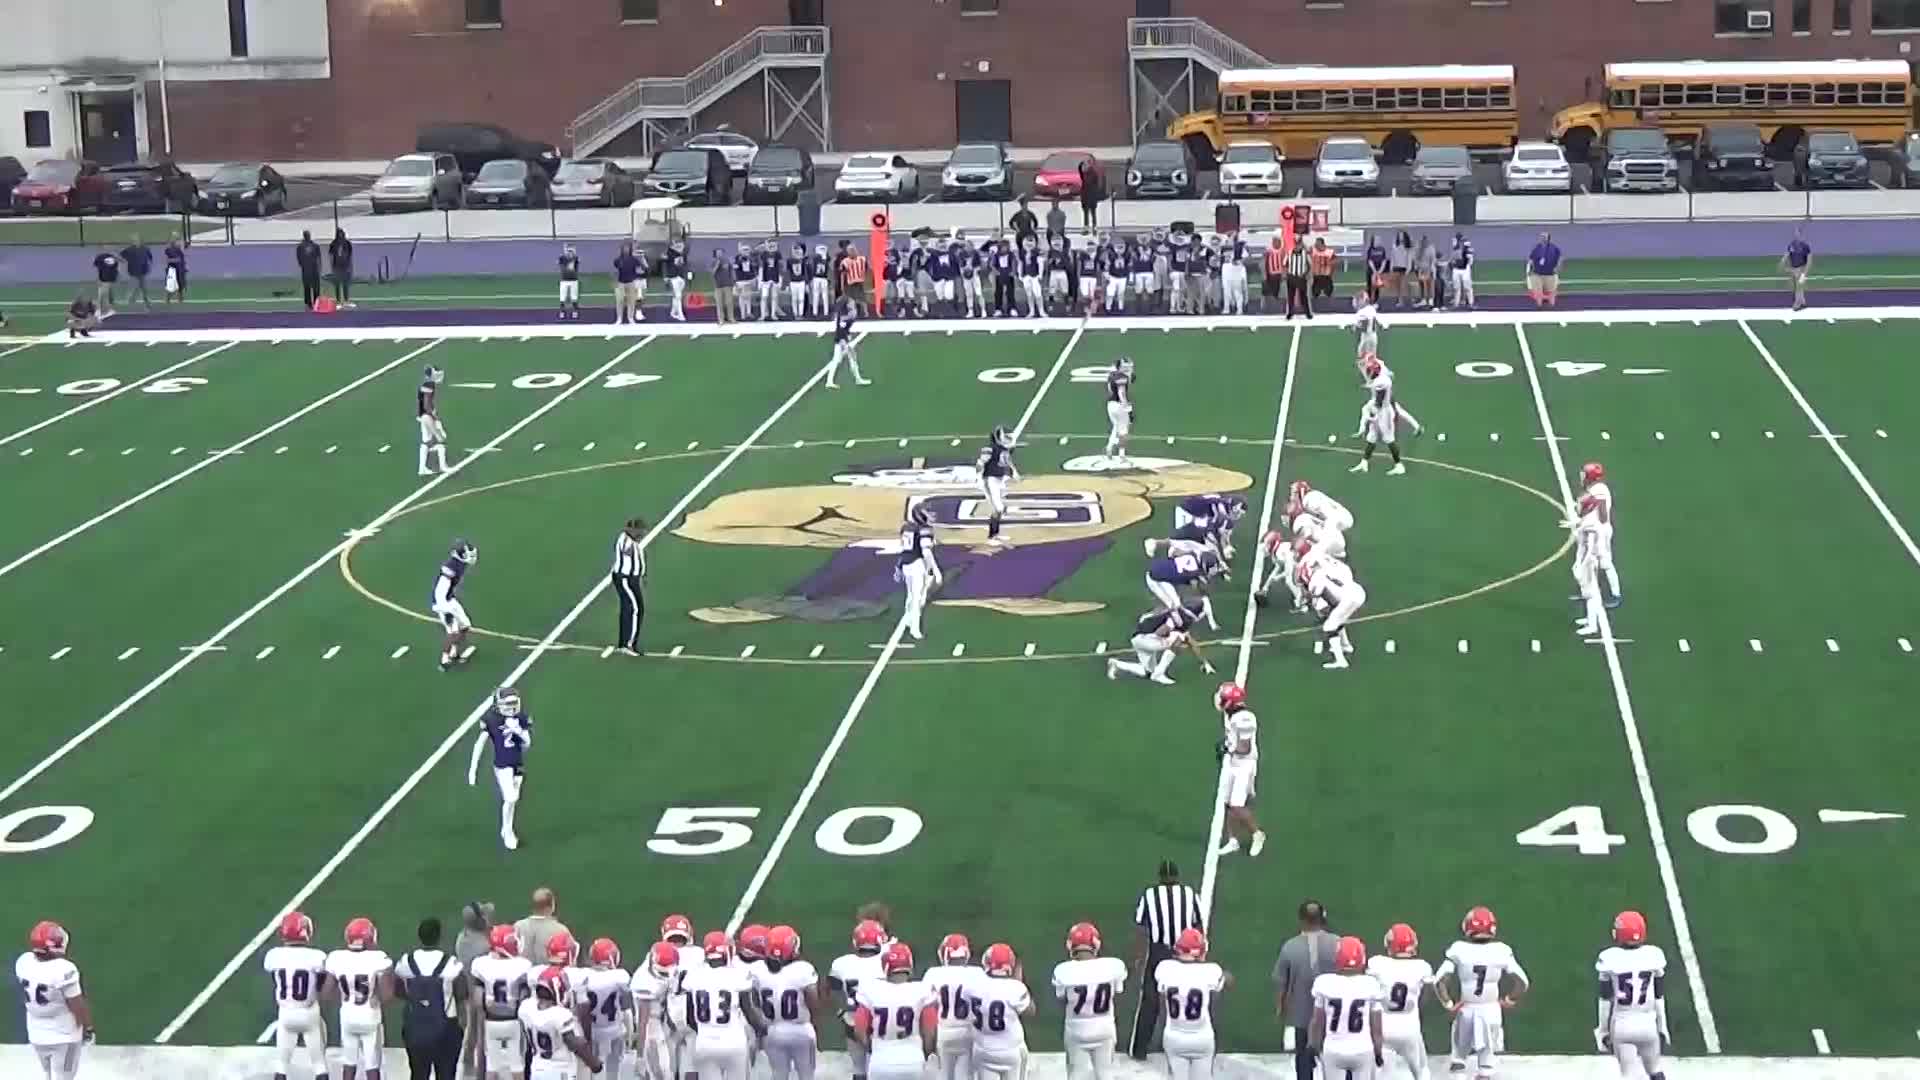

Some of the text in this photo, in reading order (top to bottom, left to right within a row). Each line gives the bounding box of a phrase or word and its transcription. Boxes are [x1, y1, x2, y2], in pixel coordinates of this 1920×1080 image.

[278, 967, 310, 1002] 10
[1390, 981, 1408, 1012] 9
[1473, 964, 1488, 997] 7
[1617, 970, 1653, 1006] 57
[939, 983, 970, 1020] 16
[1073, 983, 1112, 1015] 70
[1167, 986, 1203, 1020] 68
[873, 1005, 915, 1040] 79
